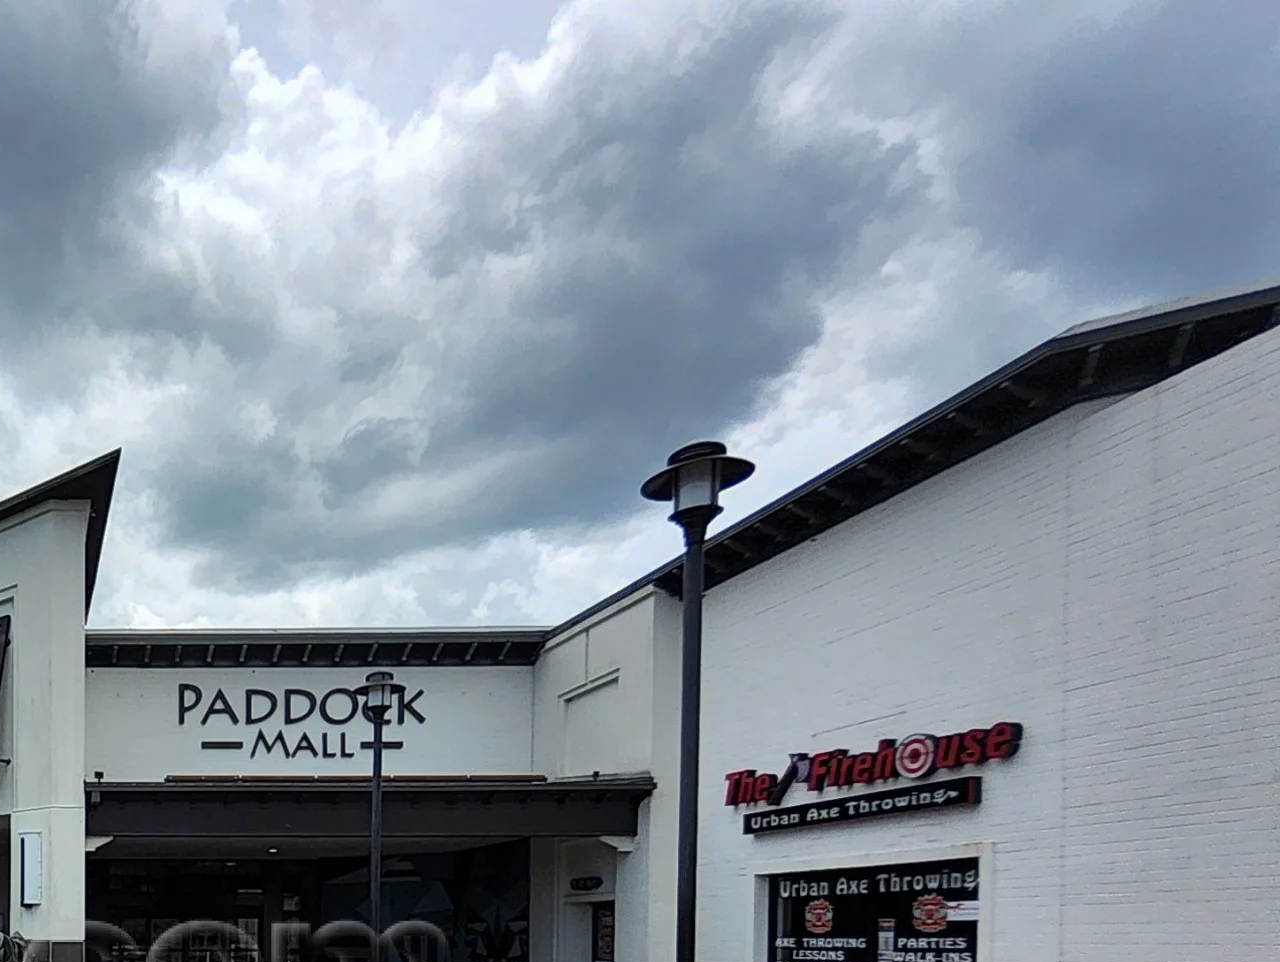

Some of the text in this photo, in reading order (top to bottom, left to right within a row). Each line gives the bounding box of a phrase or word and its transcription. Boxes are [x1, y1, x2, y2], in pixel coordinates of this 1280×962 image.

[250, 728, 355, 759] MALL
[724, 769, 778, 806] The
[751, 788, 946, 830] Urban Axe Throwing
[779, 869, 978, 898] Urban Axe Throwing
[775, 938, 867, 948] AXE THROWING
[792, 950, 845, 961] LESSONS
[897, 938, 968, 949] PARTIES
